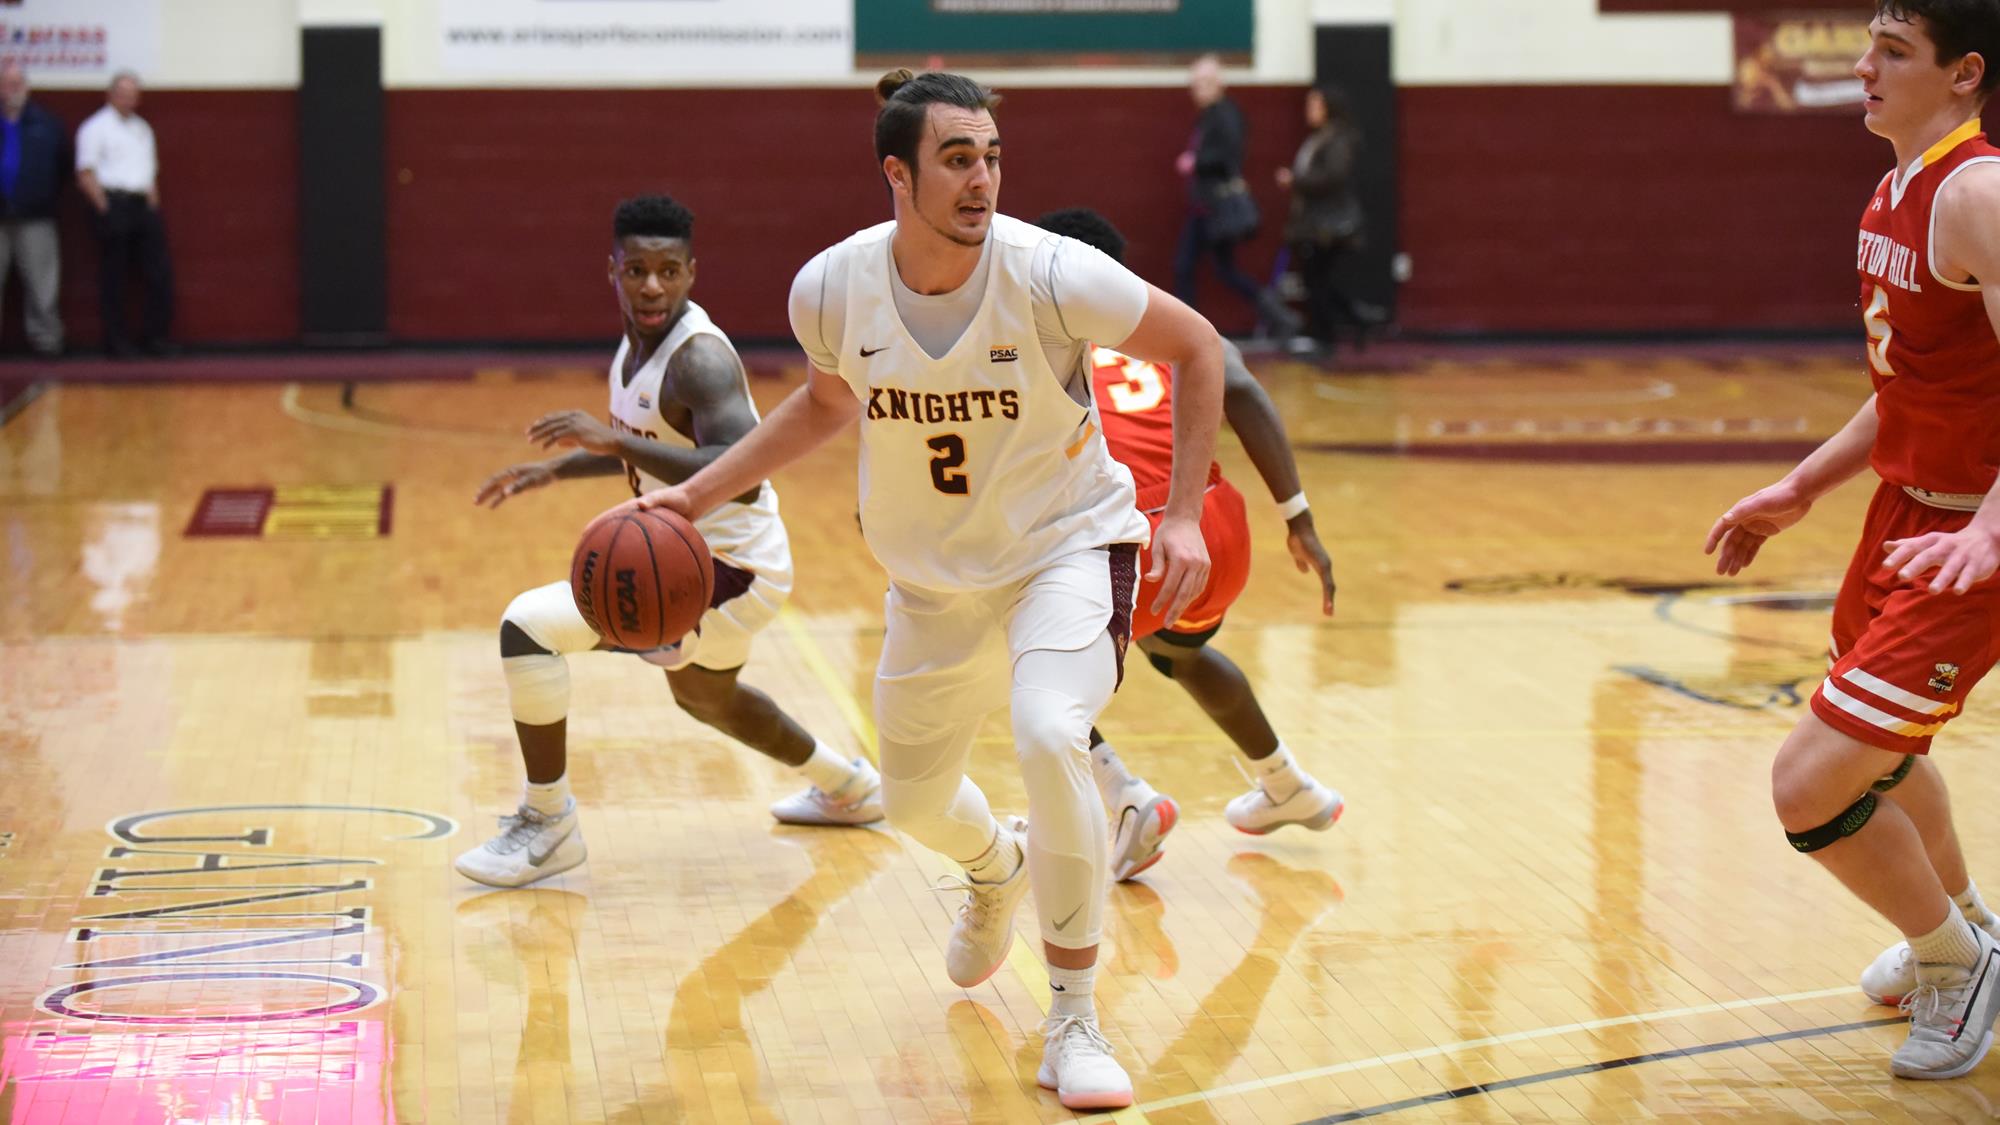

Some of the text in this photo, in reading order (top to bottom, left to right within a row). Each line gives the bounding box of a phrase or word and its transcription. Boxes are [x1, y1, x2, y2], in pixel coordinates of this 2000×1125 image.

[1888, 242, 1922, 293] HILL
[990, 348, 1018, 359] PSAC
[1864, 284, 1897, 376] 5
[867, 385, 1020, 425] KNIGHTS
[1092, 347, 1167, 414] 3
[925, 431, 971, 497] 2
[614, 567, 642, 633] NCAA
